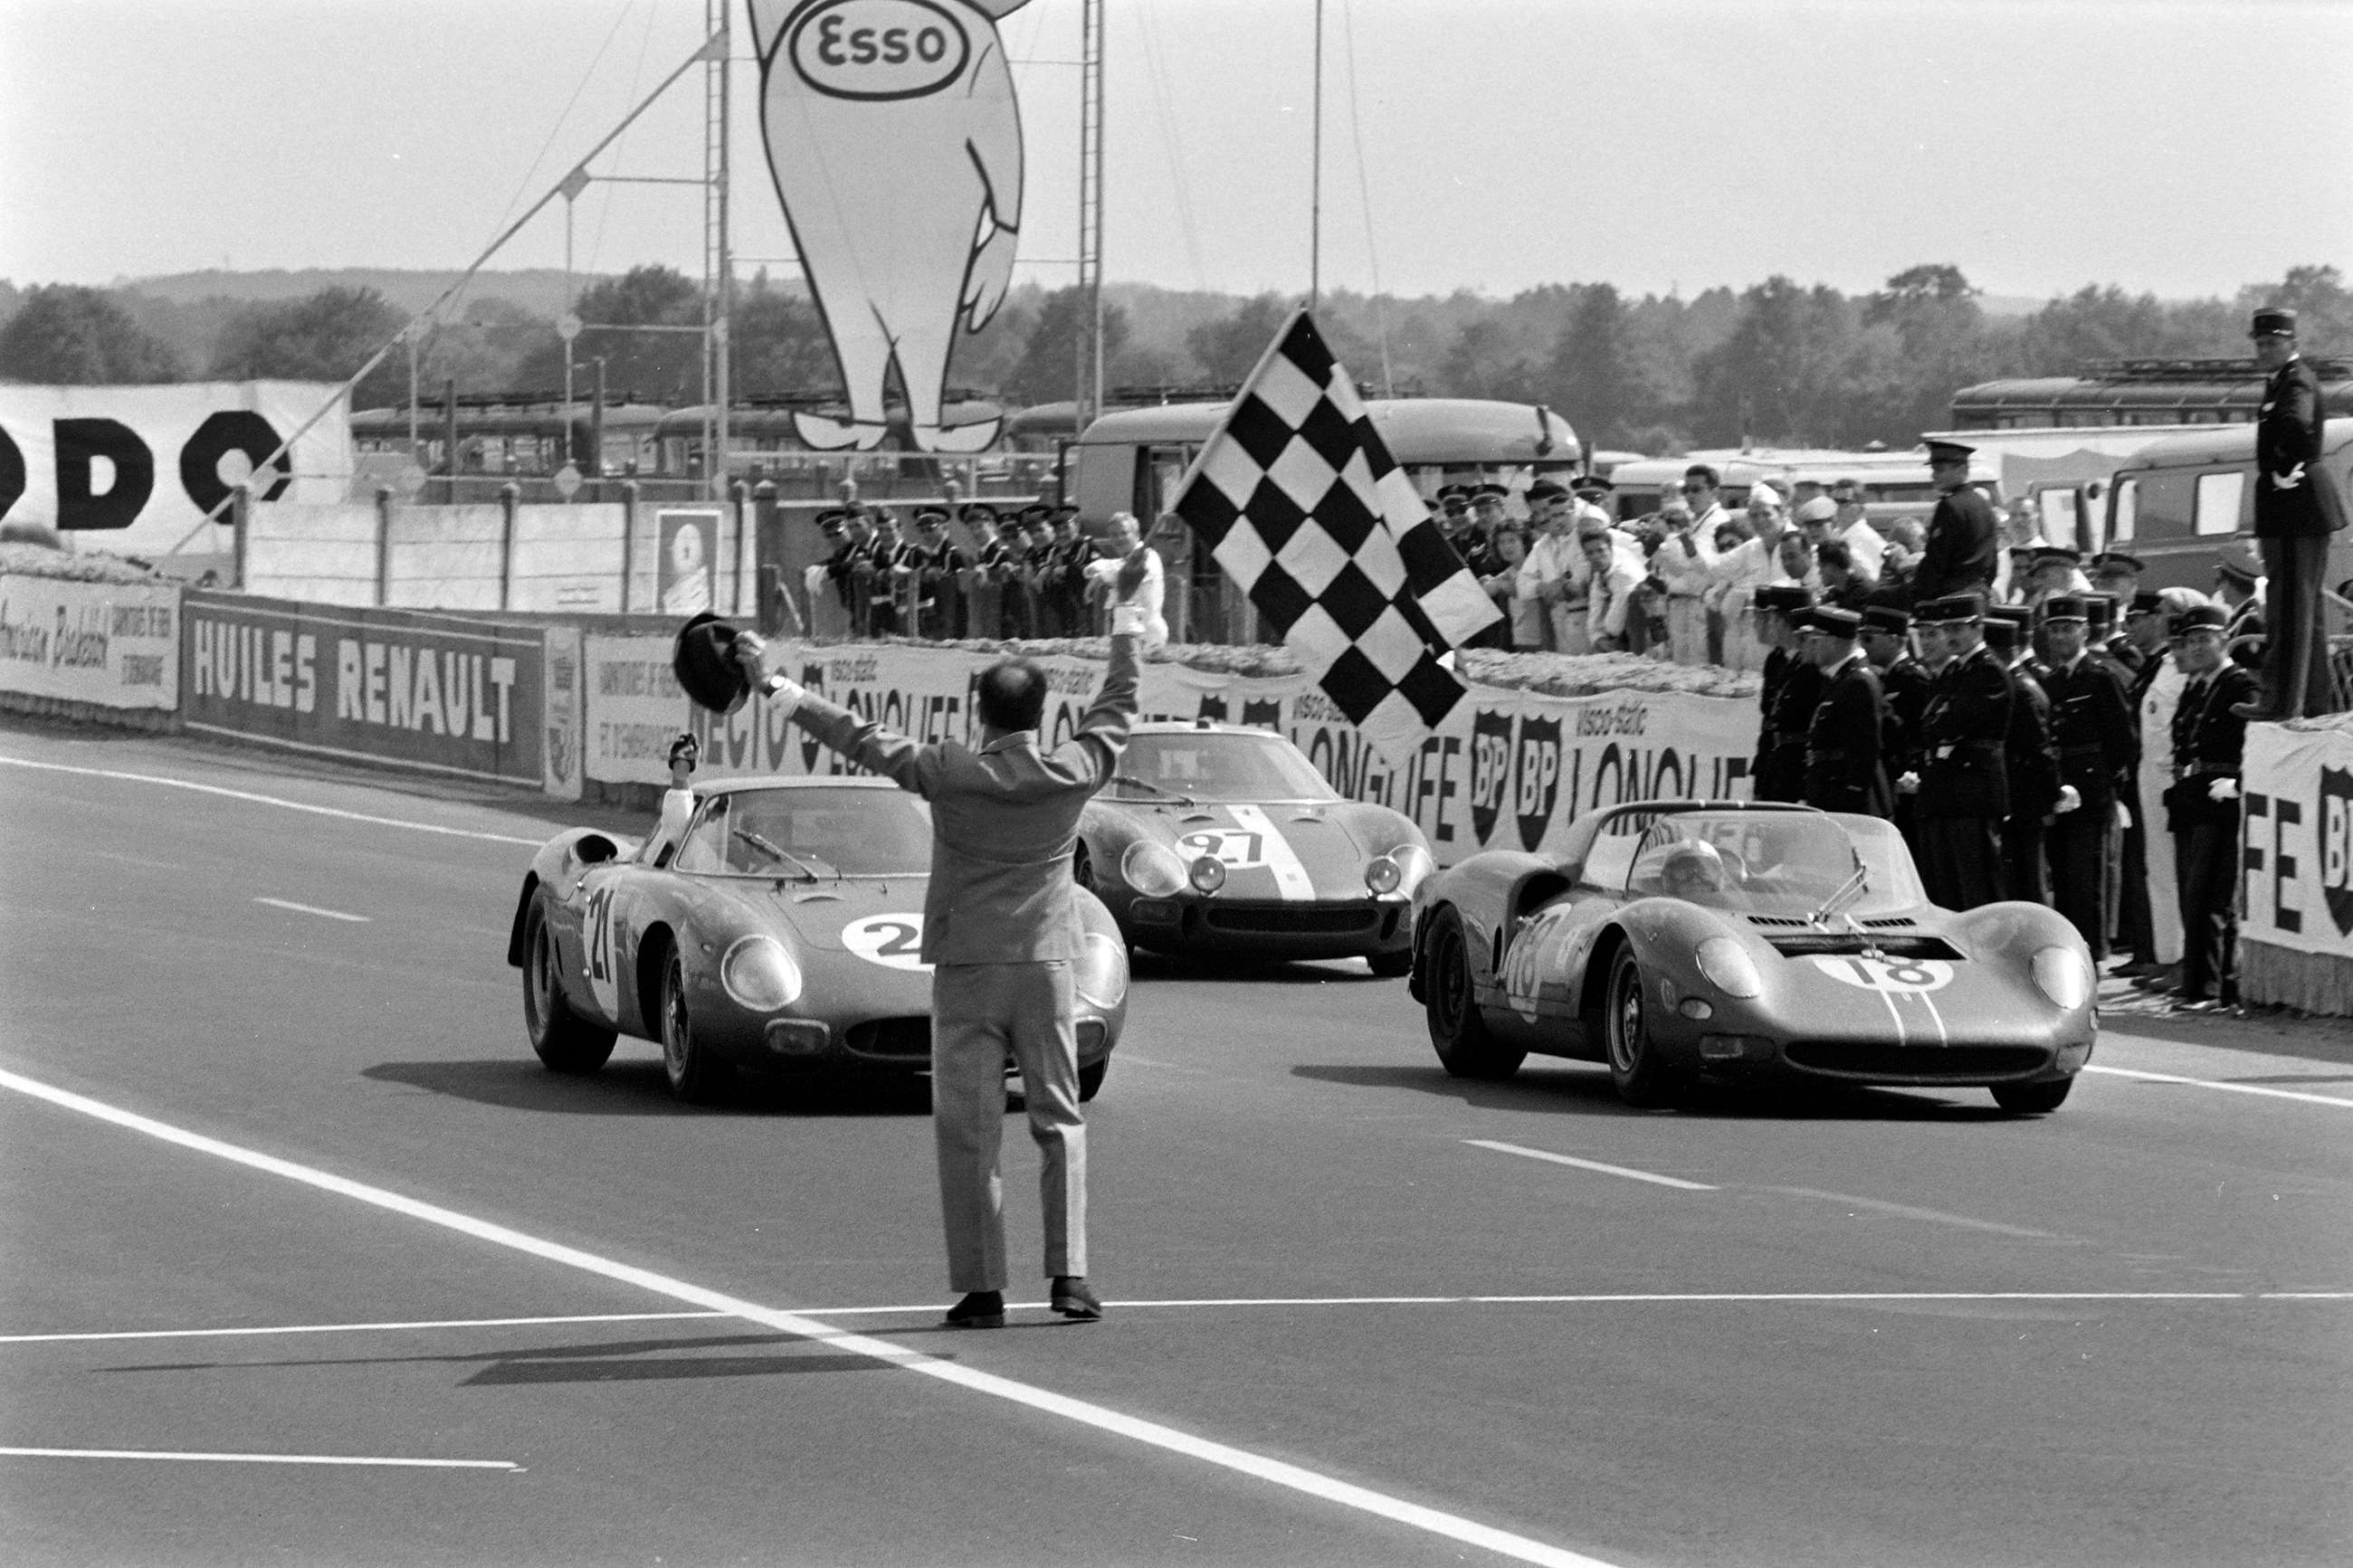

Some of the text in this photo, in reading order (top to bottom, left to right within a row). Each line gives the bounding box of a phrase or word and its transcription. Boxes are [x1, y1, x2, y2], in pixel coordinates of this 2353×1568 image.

[0, 410, 291, 531] DO
[193, 619, 316, 713] HUILES
[338, 638, 516, 744] RENAULT
[1472, 733, 1509, 810] BP
[1517, 739, 1558, 816] BP
[590, 888, 615, 984] 21
[863, 922, 921, 957] 2
[1846, 955, 1936, 985] 18
